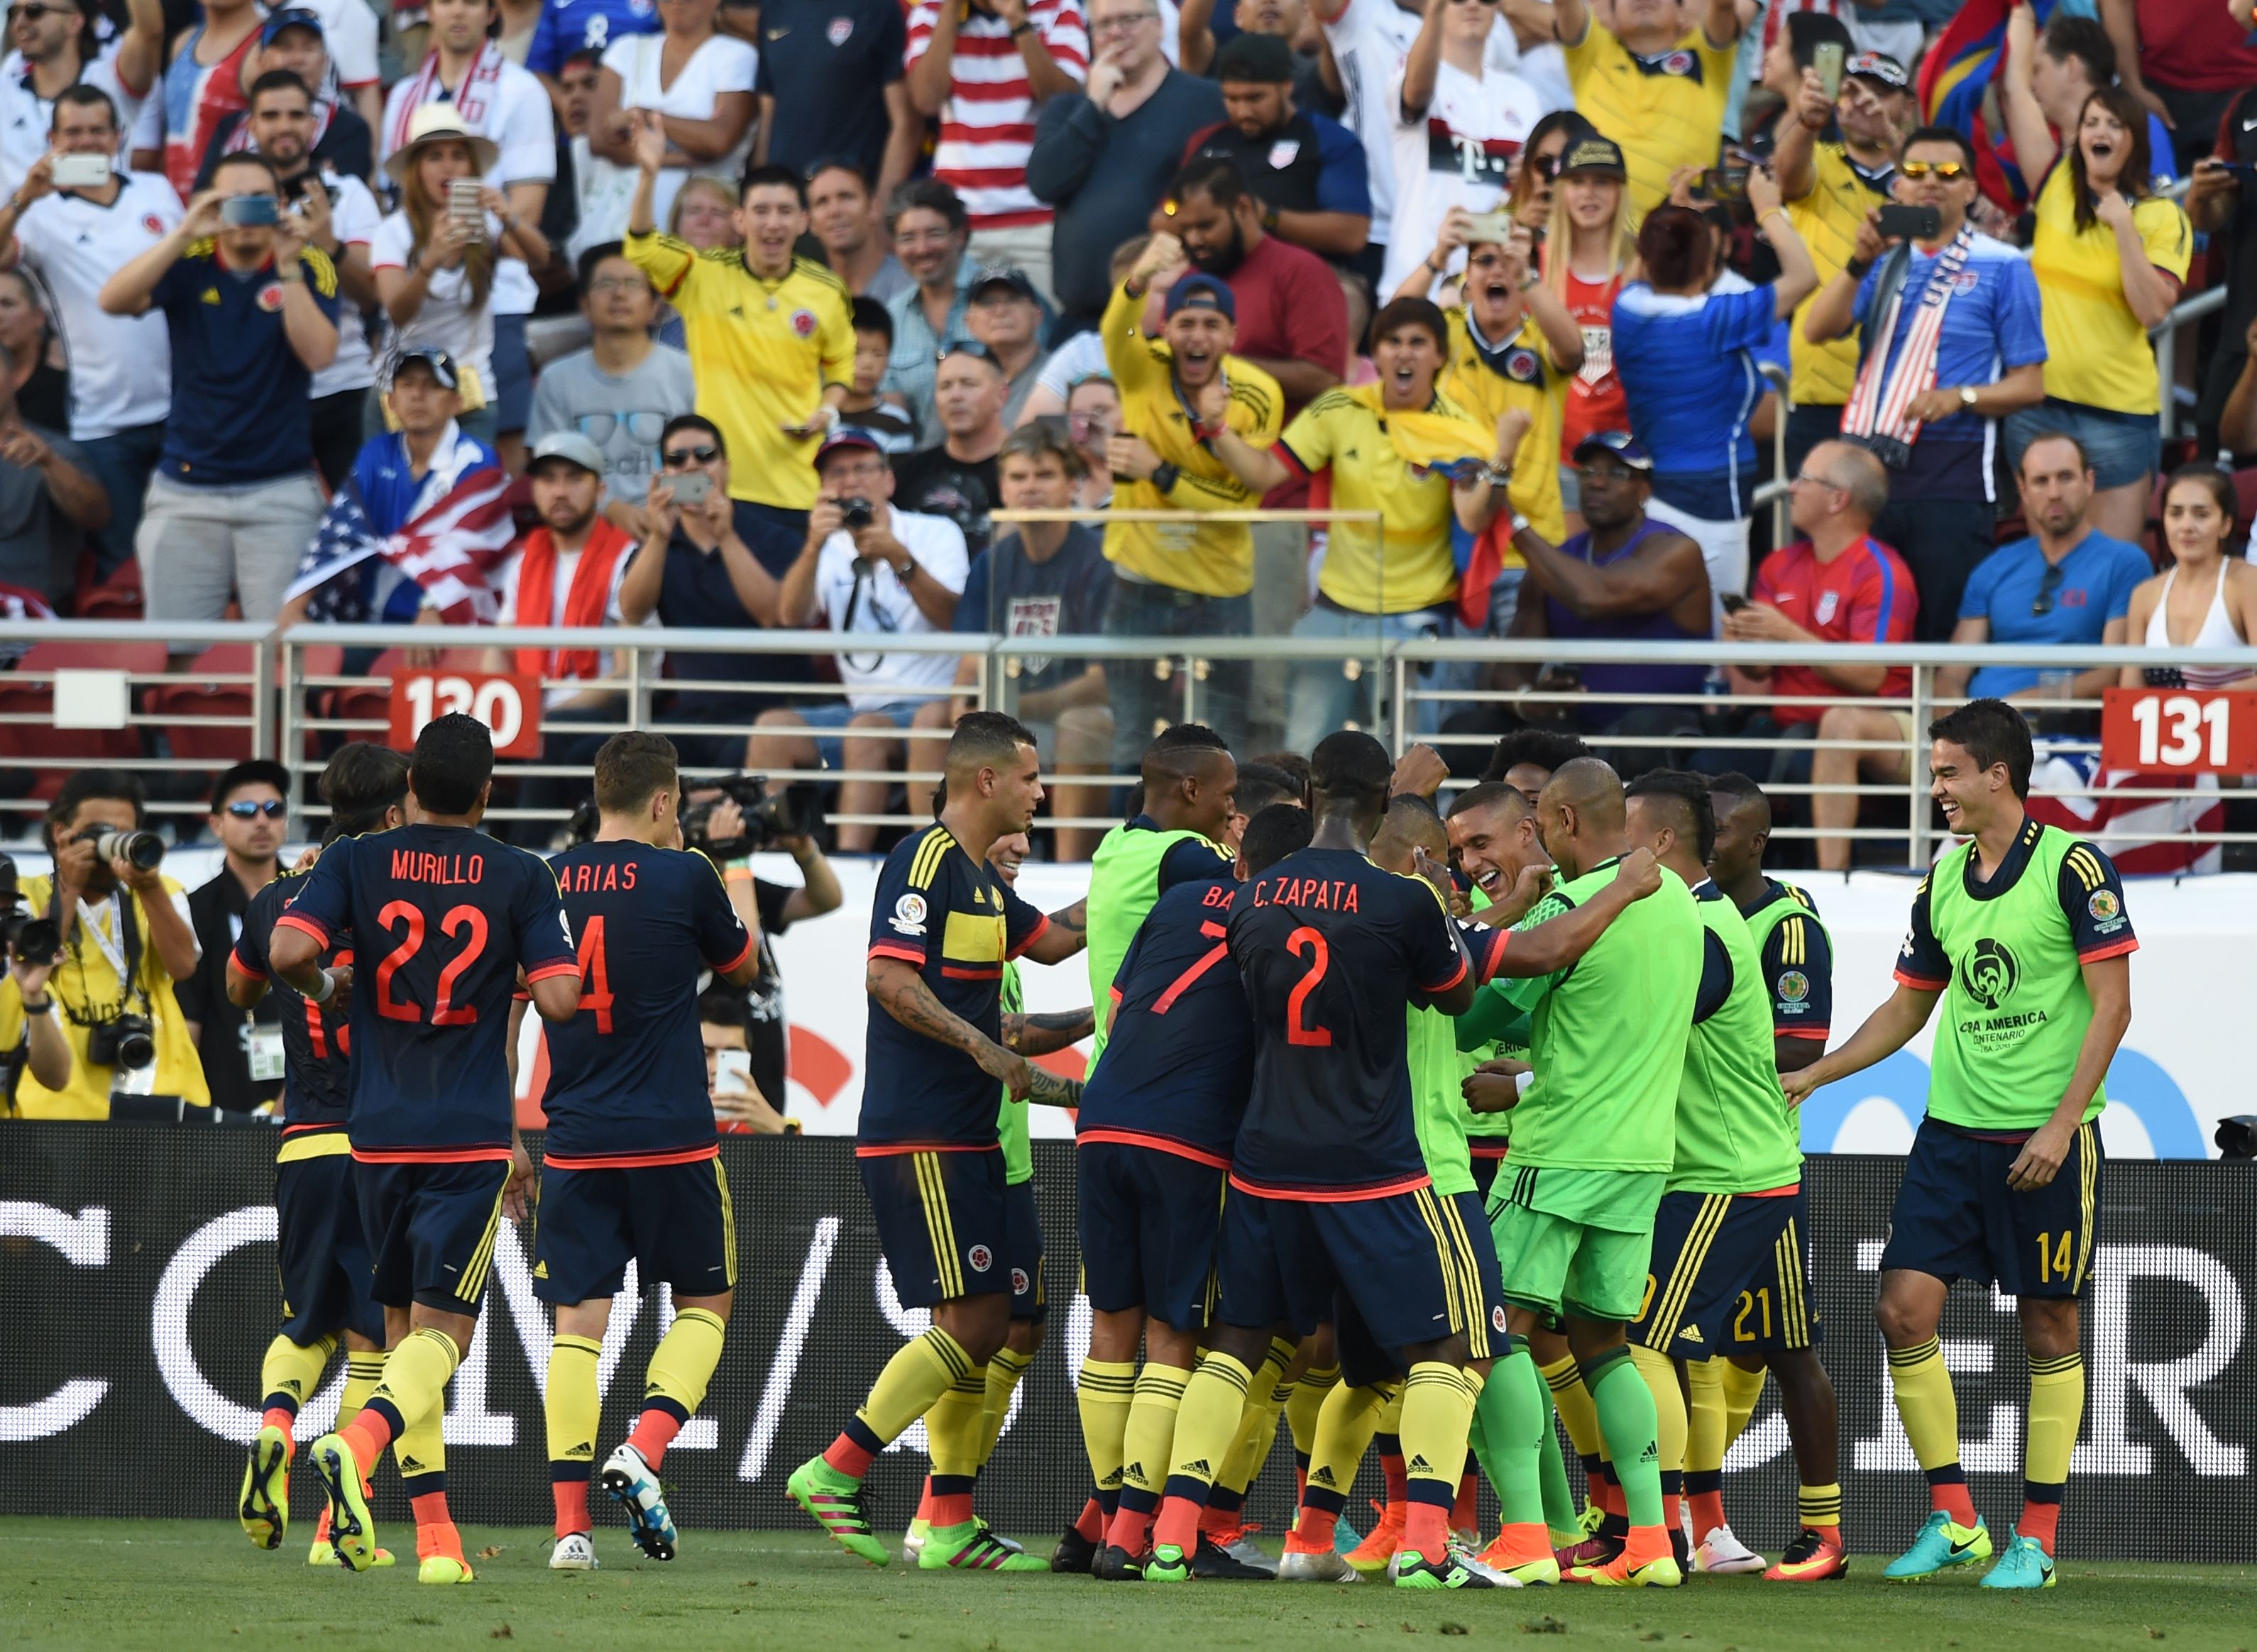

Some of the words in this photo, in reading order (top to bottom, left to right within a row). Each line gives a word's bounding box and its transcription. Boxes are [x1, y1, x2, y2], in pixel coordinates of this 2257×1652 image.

[406, 676, 522, 748] 130
[2132, 695, 2229, 766] 131
[391, 849, 484, 886] MURILLO
[559, 861, 638, 892] ARIAS
[376, 900, 489, 1026] 22
[576, 915, 615, 1034] 4
[1150, 919, 1229, 1015] 7
[1286, 926, 1331, 1047] 2
[1985, 1011, 2048, 1031] AMERICA
[2036, 1230, 2072, 1283] 14
[1678, 1331, 1703, 1343] adidas
[1734, 1287, 1772, 1342] 21
[1181, 1463, 1212, 1480] adidas
[559, 1552, 588, 1560] adidas
